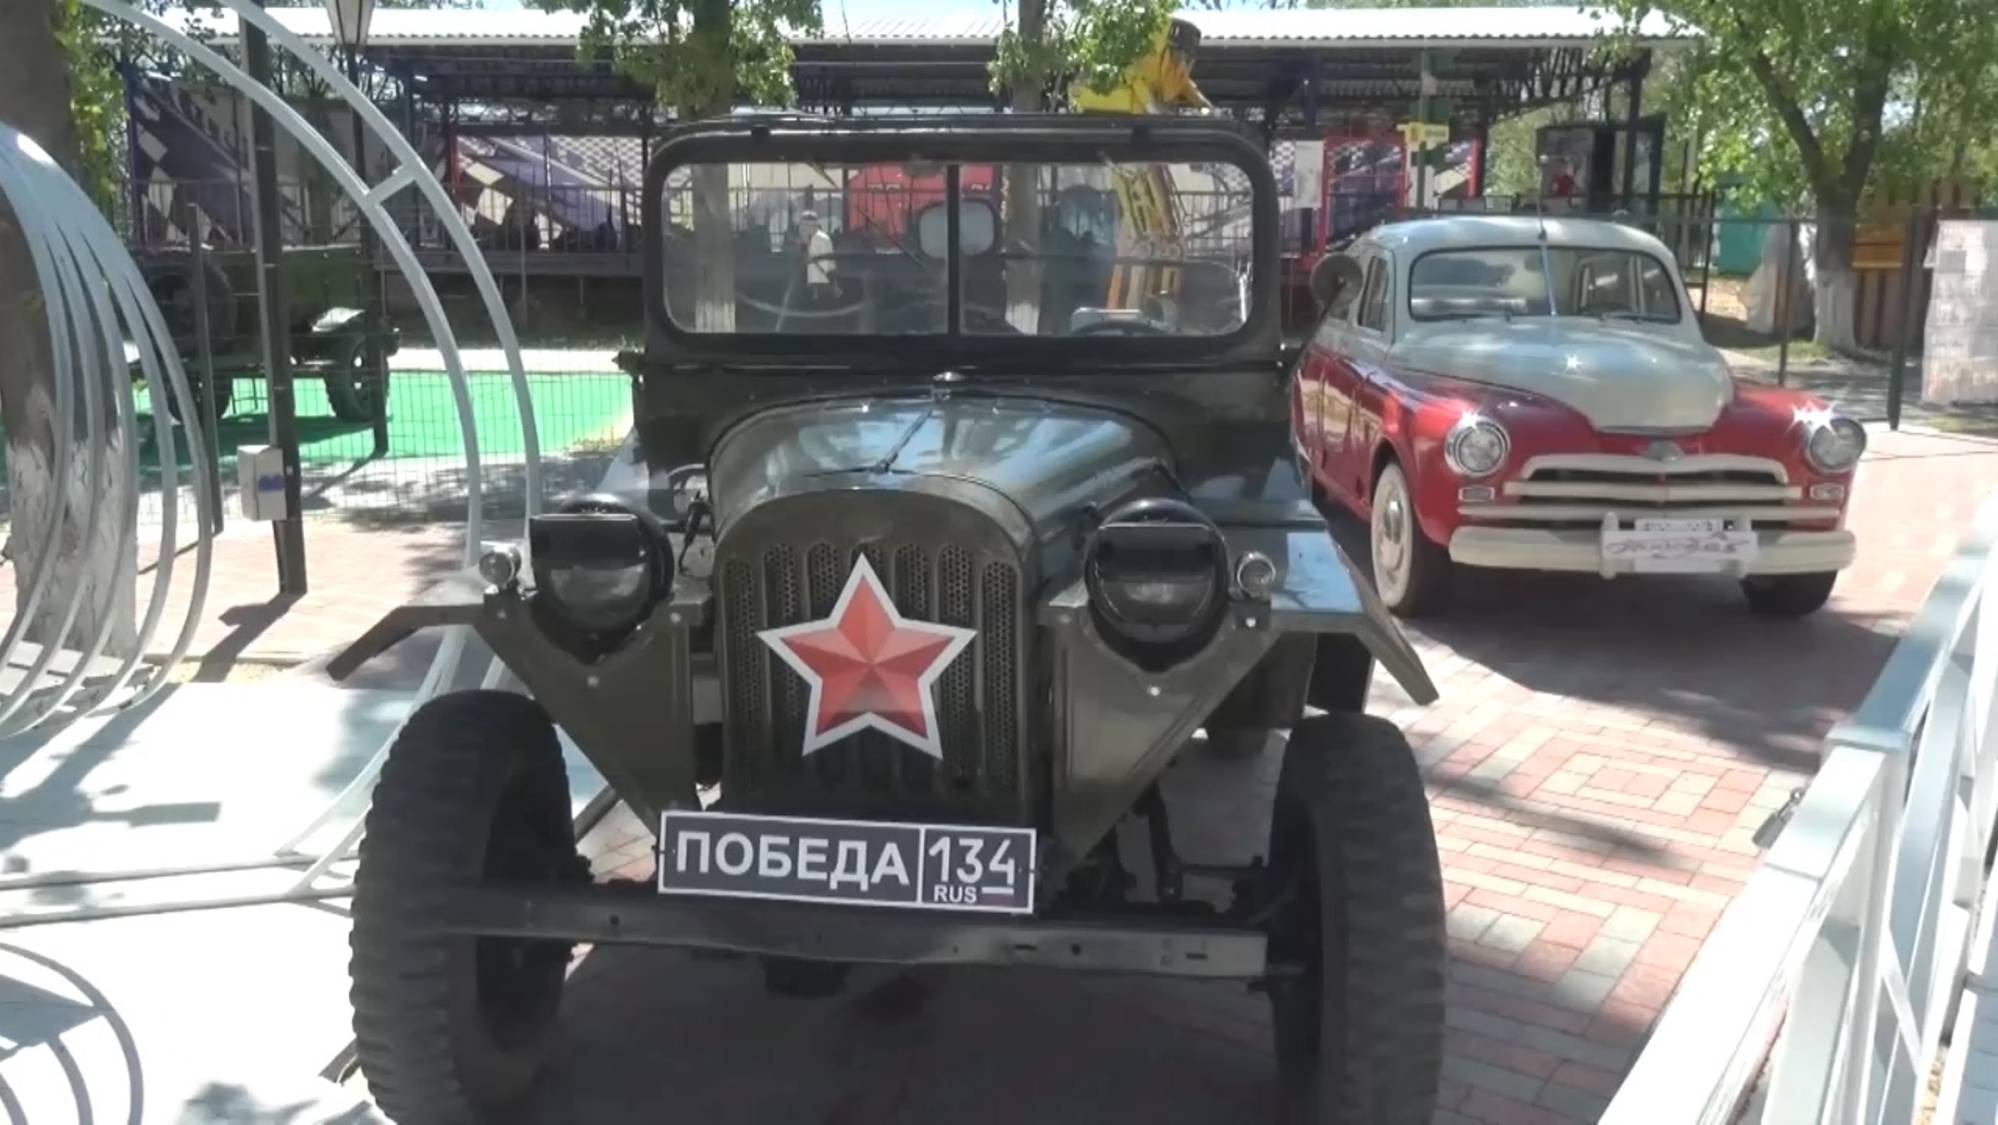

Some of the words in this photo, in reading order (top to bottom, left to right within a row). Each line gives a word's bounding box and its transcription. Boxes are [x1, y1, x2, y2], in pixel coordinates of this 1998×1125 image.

[676, 830, 910, 891] ПОБЕДА
[928, 836, 1016, 885] 134
[933, 884, 978, 904] RUS
